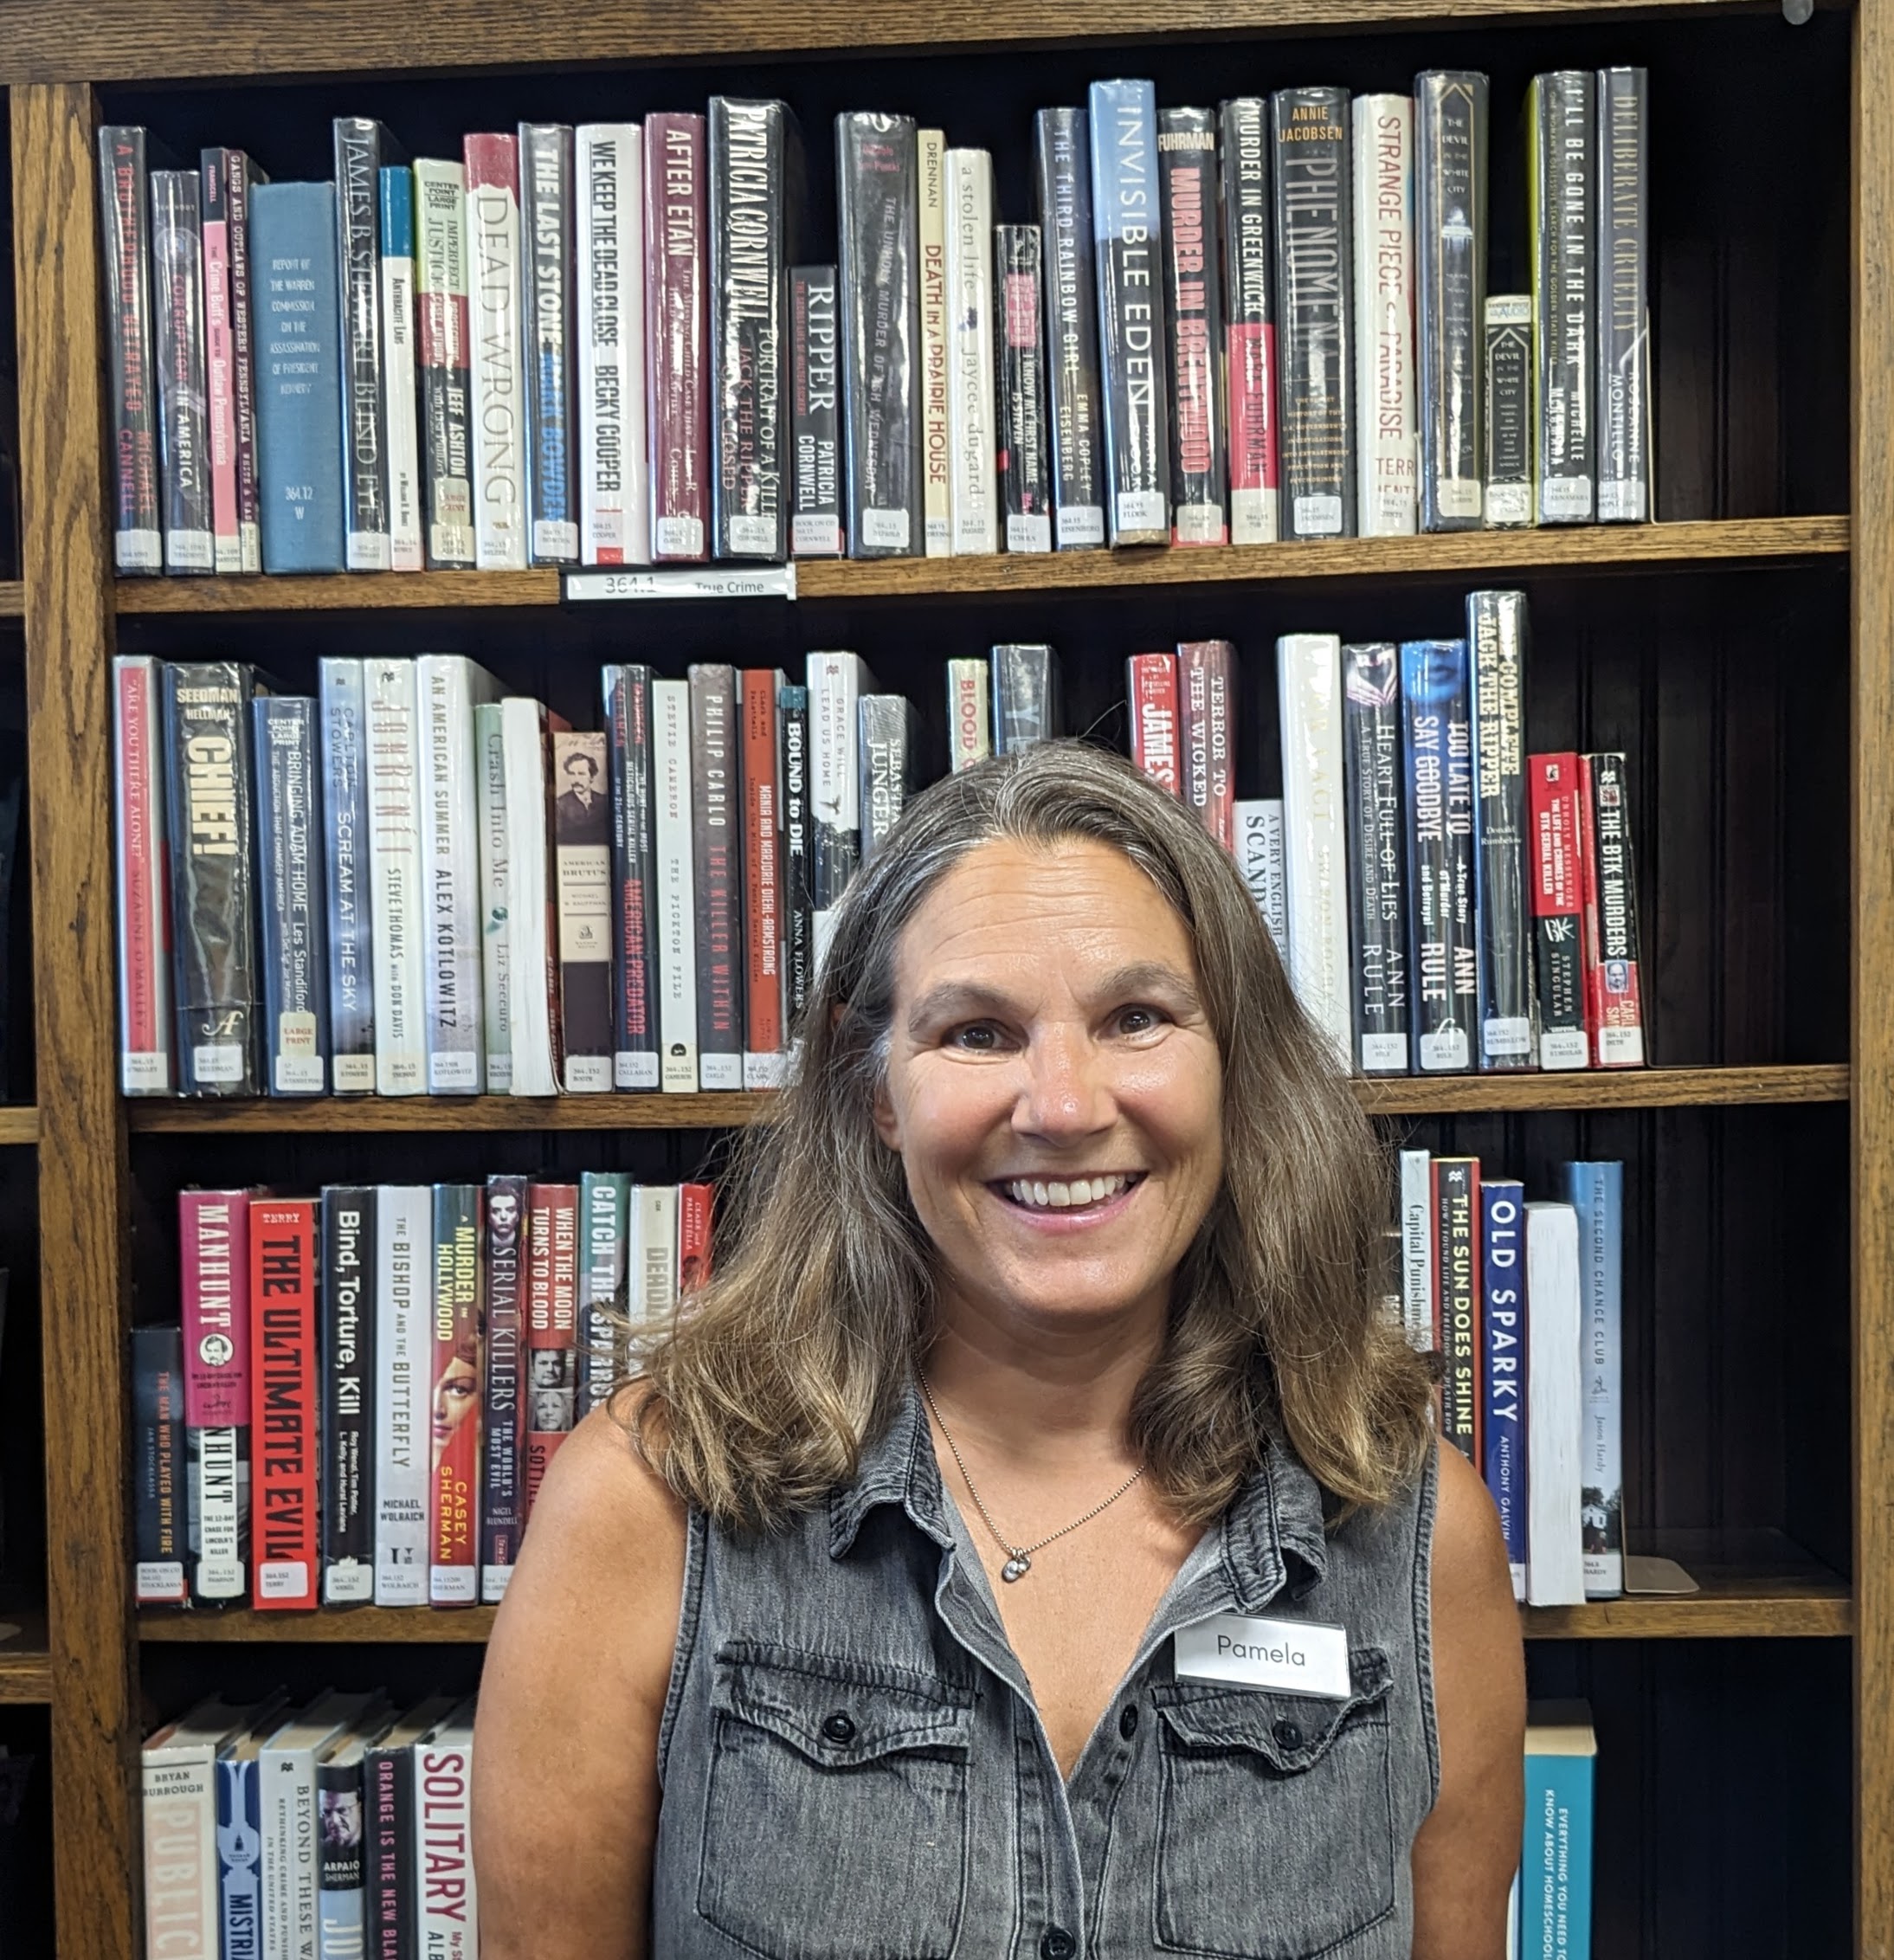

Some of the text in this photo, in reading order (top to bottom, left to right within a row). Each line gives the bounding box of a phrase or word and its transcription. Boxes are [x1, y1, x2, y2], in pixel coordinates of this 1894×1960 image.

[1157, 132, 1214, 152] FUHRMAN
[1279, 126, 1343, 143] JACOBSEN
[1292, 106, 1329, 122] ANNIE
[424, 181, 460, 190] CENTER
[428, 188, 456, 197] POINT
[429, 203, 456, 211] PRINT
[666, 130, 693, 256] AFTER ETAN
[729, 106, 769, 319] PATRICIA CORNWELL
[1117, 107, 1150, 287] INVISIBLE
[1170, 167, 1205, 273] MURDER
[1240, 110, 1266, 317] MURDER IN GREENWICH
[1565, 88, 1586, 366] I'LL BE GONE IN THE DARK
[231, 156, 251, 444] GANGS AND OUTLAWS OF WESTERN PENNSYLVANIA
[535, 149, 563, 351] THE LAST STONE
[1053, 130, 1081, 376] THE THIRD RAINBOW GIRL
[1176, 281, 1205, 311] IN
[477, 196, 517, 505] DEAD WRONG
[591, 141, 621, 493] WE KEEP THE DEAD CLOSE BECKY COOPER
[808, 285, 835, 415] RIPPER
[925, 142, 947, 485] DRENNAN DEATH IN A PRAIRIE HOUSE
[1125, 303, 1152, 405] EDEN
[285, 486, 314, 502] 364.12
[798, 435, 815, 511] CORNWELL
[817, 441, 835, 506] PATRICIA
[695, 581, 764, 594] True Crime
[177, 687, 238, 703] SEEDMAN
[960, 680, 977, 750] BLOOD
[1191, 667, 1207, 807] THE WICKED
[1211, 676, 1227, 796] TERROR TO
[188, 737, 237, 854] CHIEF!
[788, 723, 802, 793] BOUND
[1414, 716, 1442, 842] SAY GOODBYE
[1447, 720, 1472, 835] TOO LATE TO
[431, 676, 457, 1028] AN AMERICAN SUMMER ALEX KOTLOWITZ
[705, 695, 731, 1030] PHILIP CARLO THE KILLER WITHIN
[1268, 814, 1283, 936] A VERY ENGLISH
[1601, 811, 1627, 957] THE BTK MURDERS
[338, 812, 358, 1011] SCREAM AT THE SKY
[1363, 944, 1384, 1015] RULE
[1387, 950, 1405, 1008] ANN
[1420, 942, 1446, 1002] RULE
[1453, 946, 1475, 994] ANN
[198, 1204, 231, 1327] MANHUNT
[263, 1213, 300, 1223] TERRY
[455, 1227, 475, 1303] MURDER
[531, 1208, 550, 1330] TURNS TO BLOOD
[554, 1208, 573, 1331] WHEN THE MOON
[1594, 1179, 1605, 1364] THE SECOND CHANCE CLUB
[335, 1211, 360, 1415] Bind, Torture, Kill
[392, 1217, 411, 1467] THE BISHOP AND THE BUTTERFLY
[437, 1244, 454, 1341] HOLLYWOOD
[461, 1308, 468, 1318] IN
[492, 1247, 516, 1411] SERIAL KILLERS
[1453, 1195, 1472, 1435] THE SUN DOES SHINE
[1491, 1200, 1517, 1422] OLD SPARKY
[262, 1235, 304, 1559] THE ULTIMATE EVIL
[381, 1512, 424, 1521] WOLRAICH
[383, 1499, 421, 1509] MICHAEL
[441, 1466, 452, 1560] SHERMAN
[454, 1481, 467, 1545] CASEY
[1499, 1435, 1511, 1540] ANTHONY GALVIN
[1217, 1634, 1305, 1667] Pamela
[143, 1783, 203, 1797] BURROUGH
[154, 1770, 190, 1783] BRYAN
[1544, 1789, 1555, 1871] KNOW ABOUT
[323, 1860, 359, 1871] ARPAIO
[379, 1761, 396, 1921] ORANGE IS THE NEW
[423, 1753, 466, 1922] SOLITARY
[1557, 1808, 1569, 1945] EVERYTHING YOU NEED
